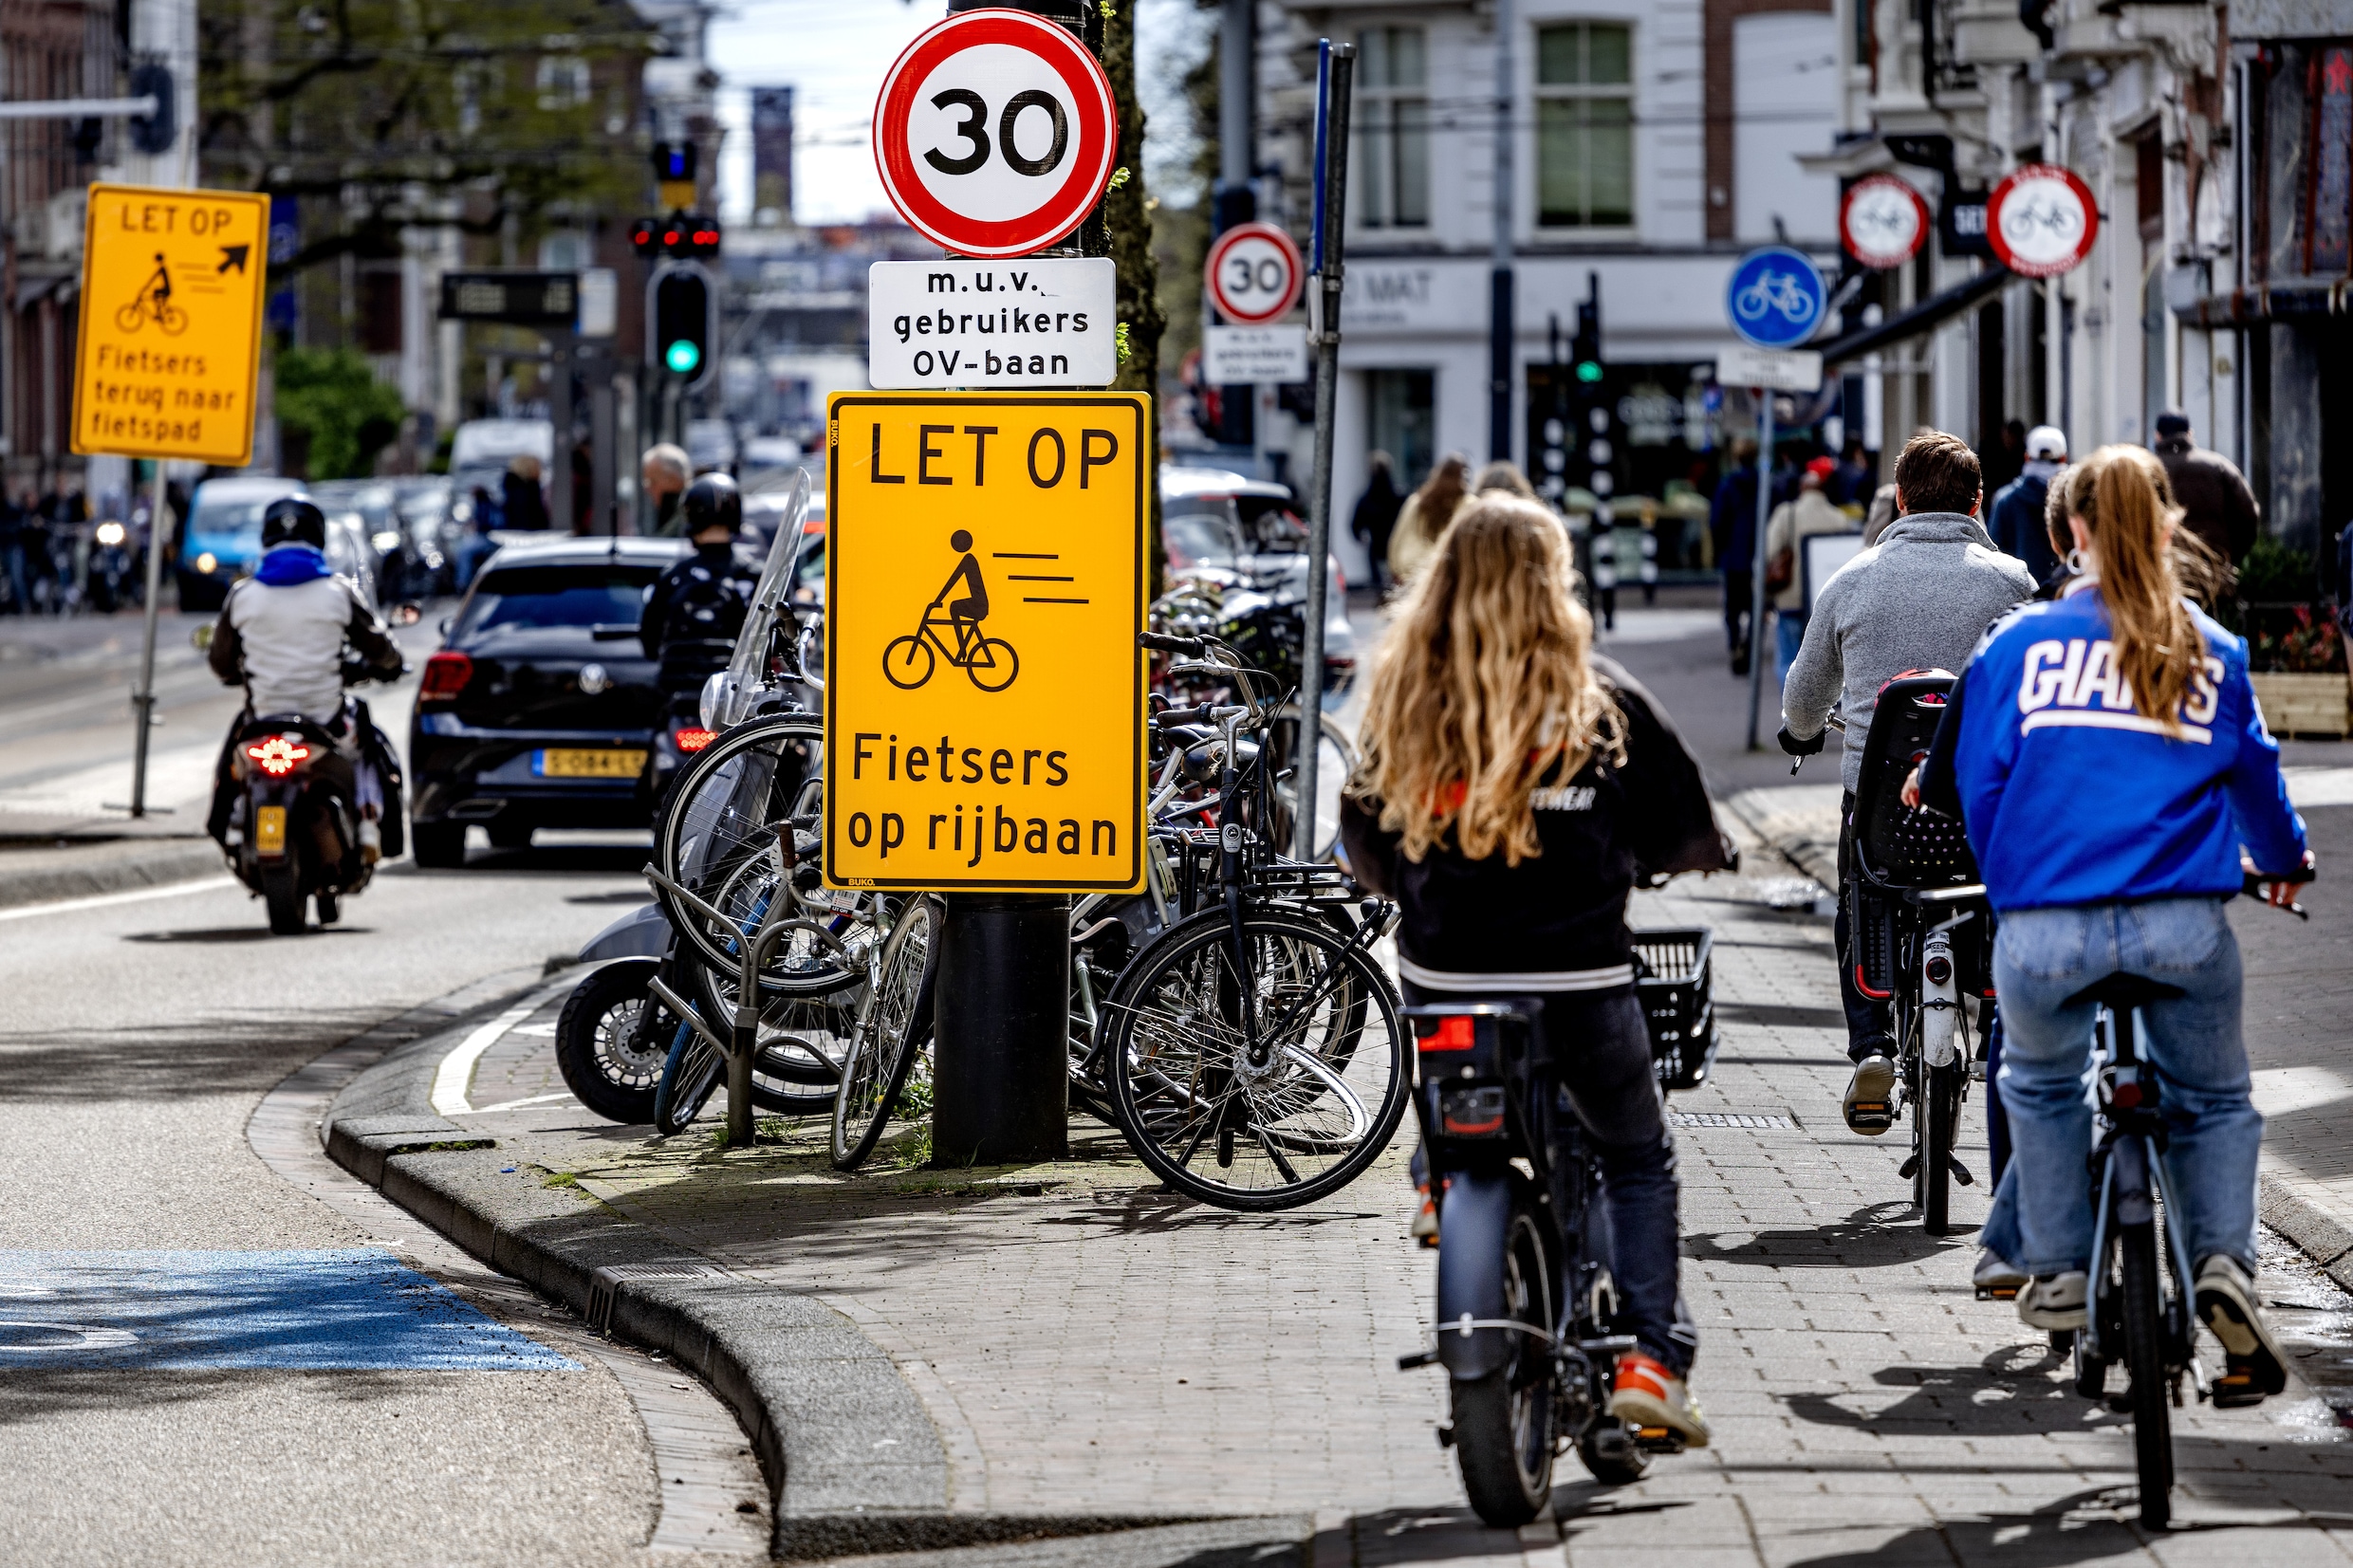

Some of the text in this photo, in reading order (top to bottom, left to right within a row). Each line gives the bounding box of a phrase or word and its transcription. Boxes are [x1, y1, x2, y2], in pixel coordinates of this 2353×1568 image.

[923, 88, 1068, 176] 30
[120, 203, 233, 236] LET OP
[928, 272, 1038, 293] m.u.v.
[1229, 258, 1283, 294] 30
[894, 307, 1088, 343] gebruikers
[97, 344, 207, 376] Fietsers
[913, 349, 1068, 377] OV-baan
[95, 380, 236, 413] terug naar
[92, 412, 201, 443] fietspad
[870, 422, 1119, 489] LET OP
[2018, 638, 2225, 725] GIAS
[853, 732, 1069, 786] Fietsers
[848, 804, 1117, 868] op rijbaan
